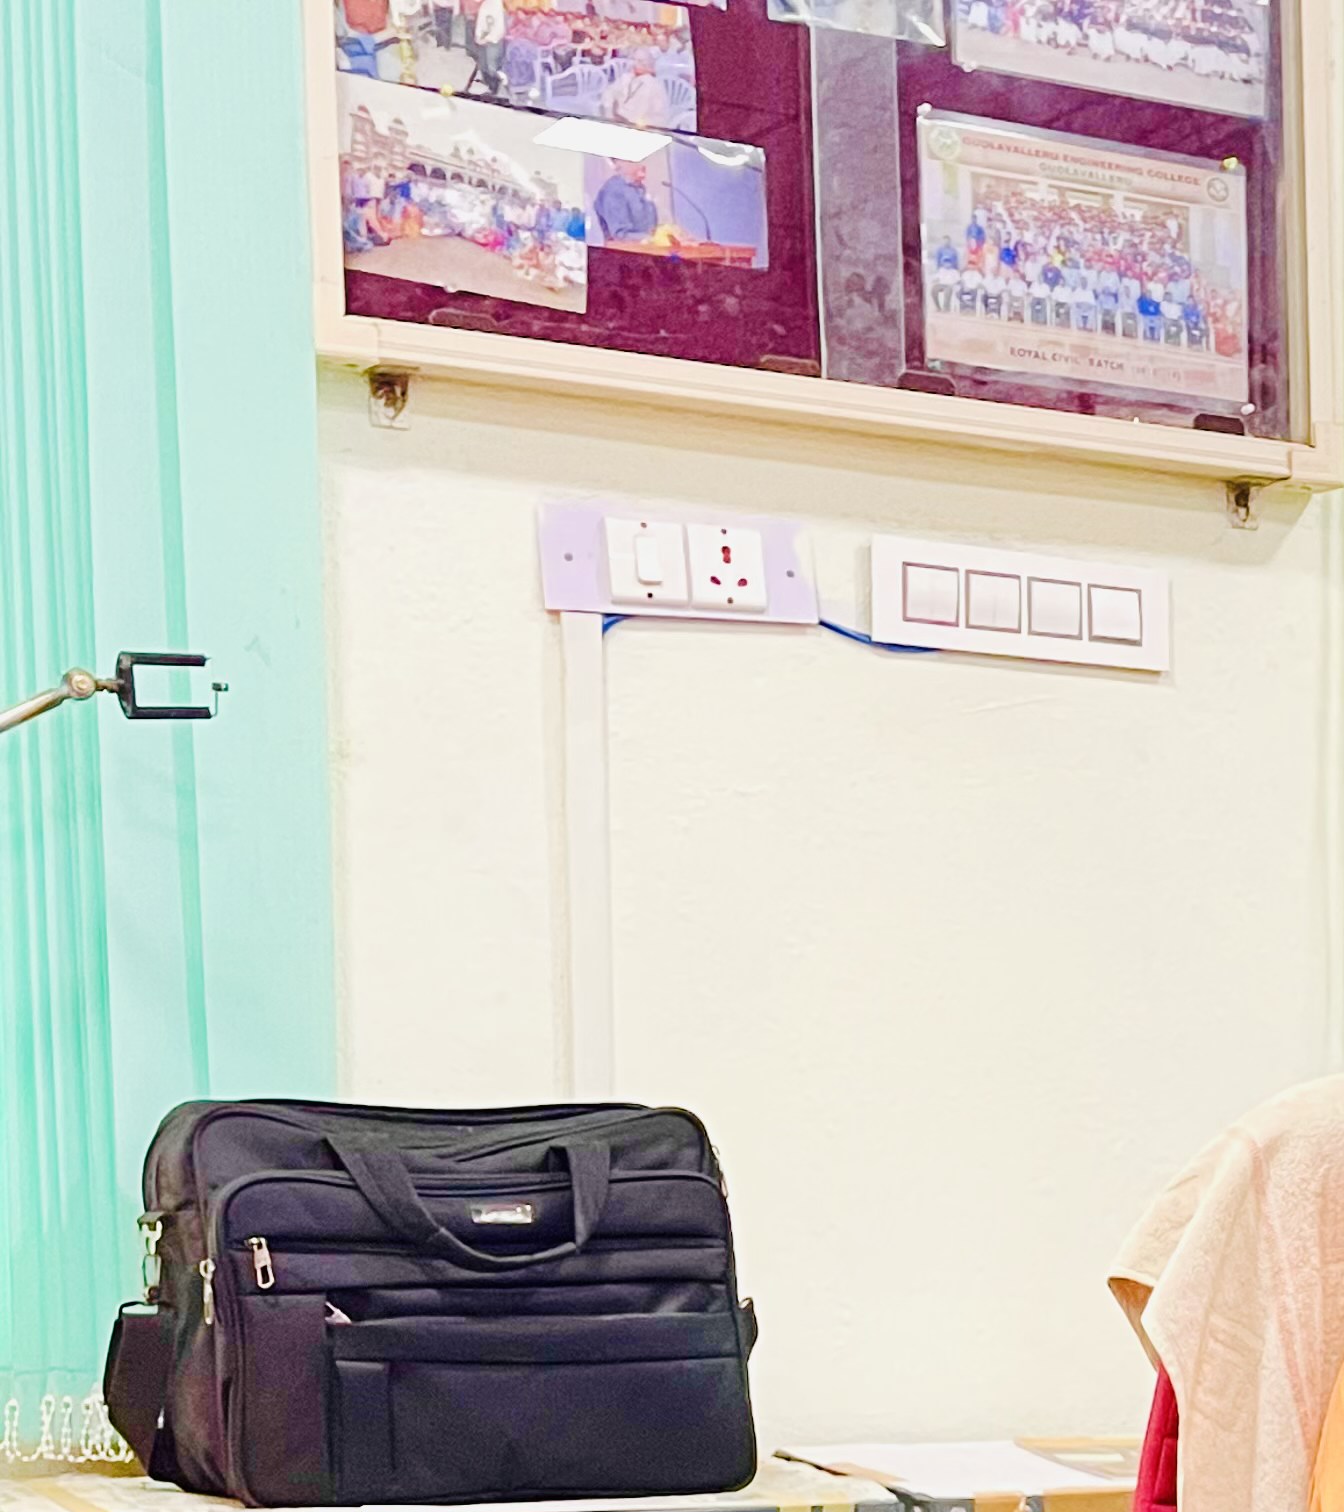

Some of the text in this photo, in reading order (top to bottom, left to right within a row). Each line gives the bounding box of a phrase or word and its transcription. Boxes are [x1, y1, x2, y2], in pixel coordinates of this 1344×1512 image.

[1062, 153, 1143, 176] ENGINEERING
[1147, 168, 1201, 186] COLLEGE
[1009, 346, 1047, 362] ROYAL
[1088, 357, 1125, 372] BATCH
